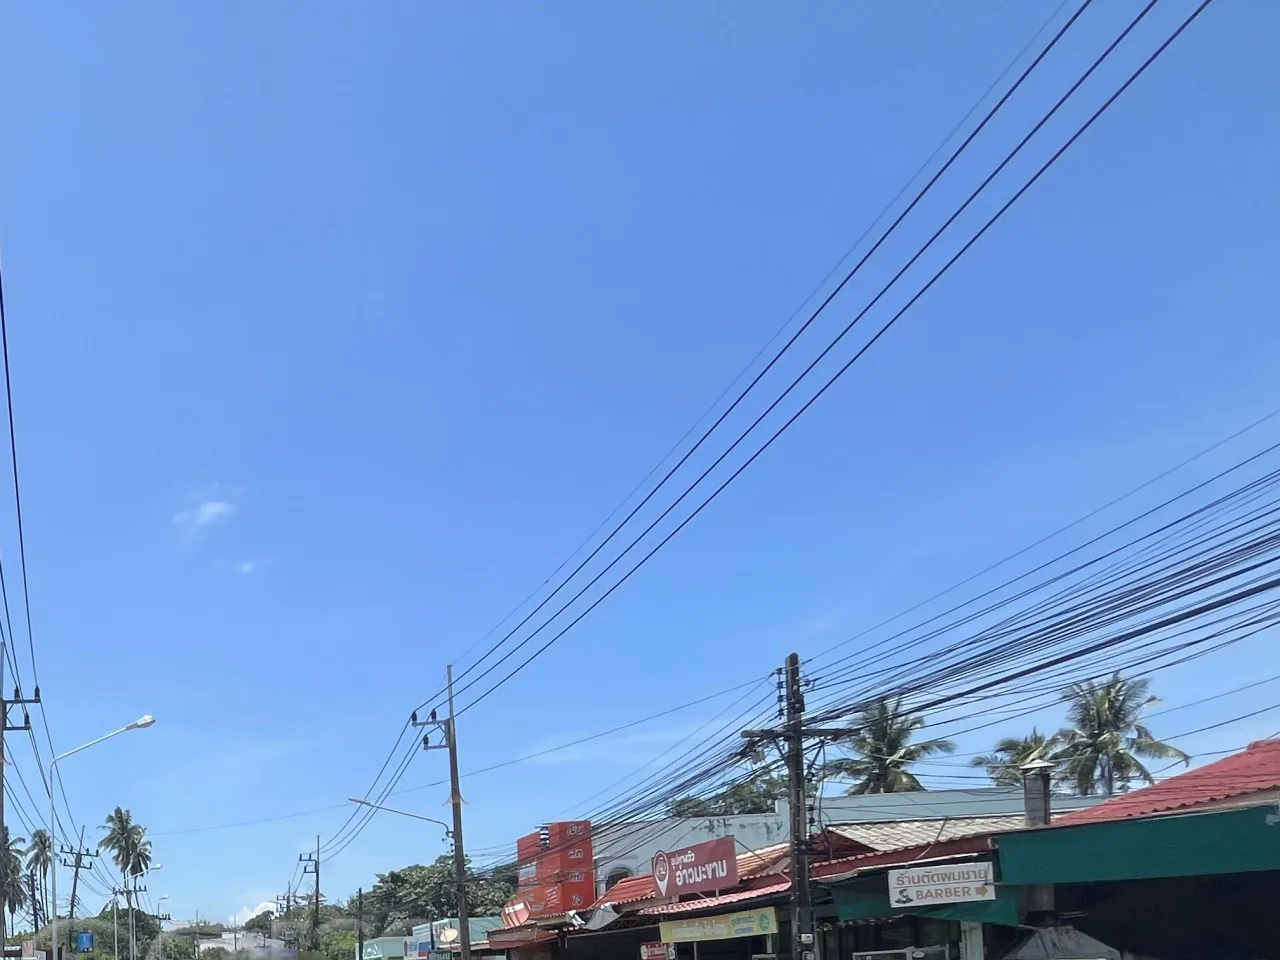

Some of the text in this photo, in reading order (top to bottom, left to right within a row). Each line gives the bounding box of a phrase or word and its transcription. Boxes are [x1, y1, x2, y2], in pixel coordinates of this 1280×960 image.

[675, 859, 728, 887] อ่าวมะขาม
[896, 868, 989, 887] ร้านตัดผมชาย
[915, 886, 971, 900] BARBER
